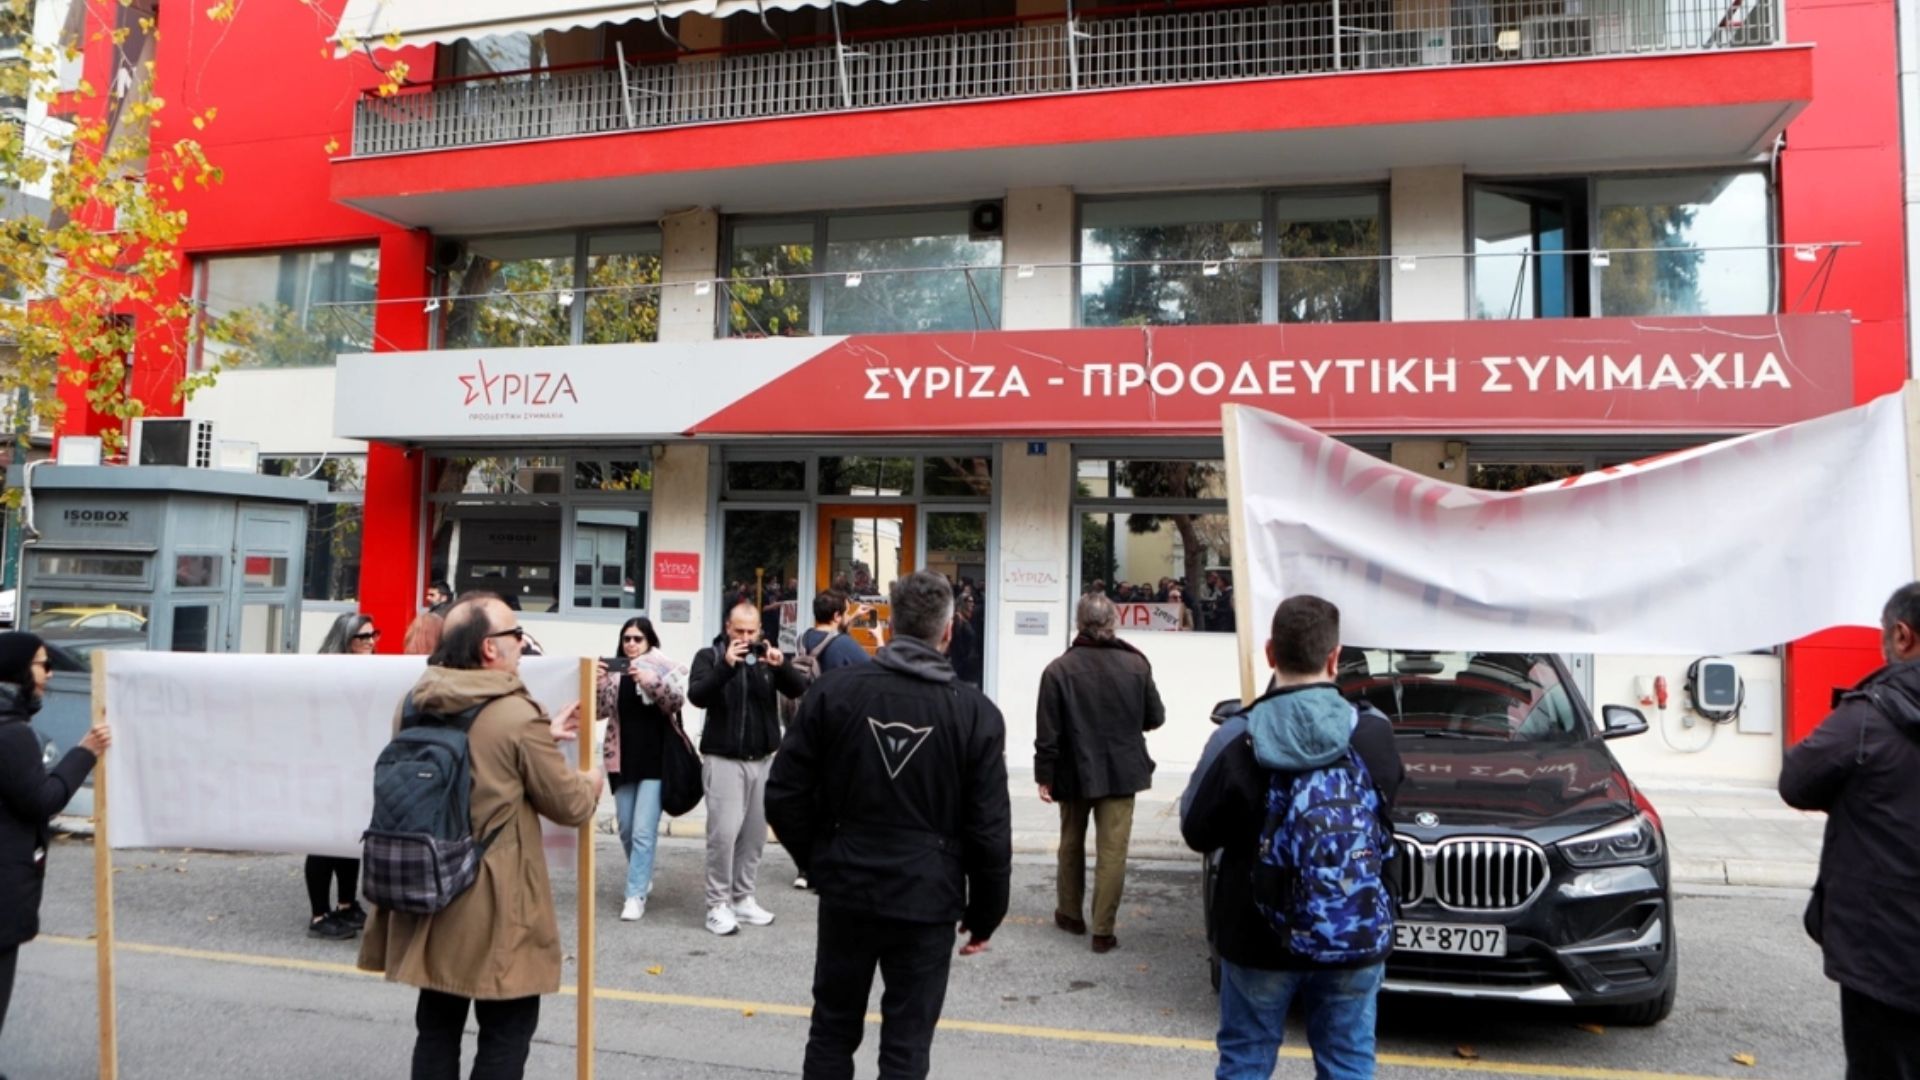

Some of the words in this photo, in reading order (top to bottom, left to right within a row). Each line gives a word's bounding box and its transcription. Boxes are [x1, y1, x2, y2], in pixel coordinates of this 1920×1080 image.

[458, 358, 578, 406] ΣΥΡΙΖΑ
[863, 365, 1031, 400] ΣΥΡΙΖΑ
[1082, 357, 1458, 397] ΠΡΟΟΔΕΥΤΙΚΗ
[1481, 351, 1792, 393] ΣΥΜΜΑΧΙΑ
[64, 509, 129, 521] ISOBOX
[1394, 925, 1500, 953] EX-8707
